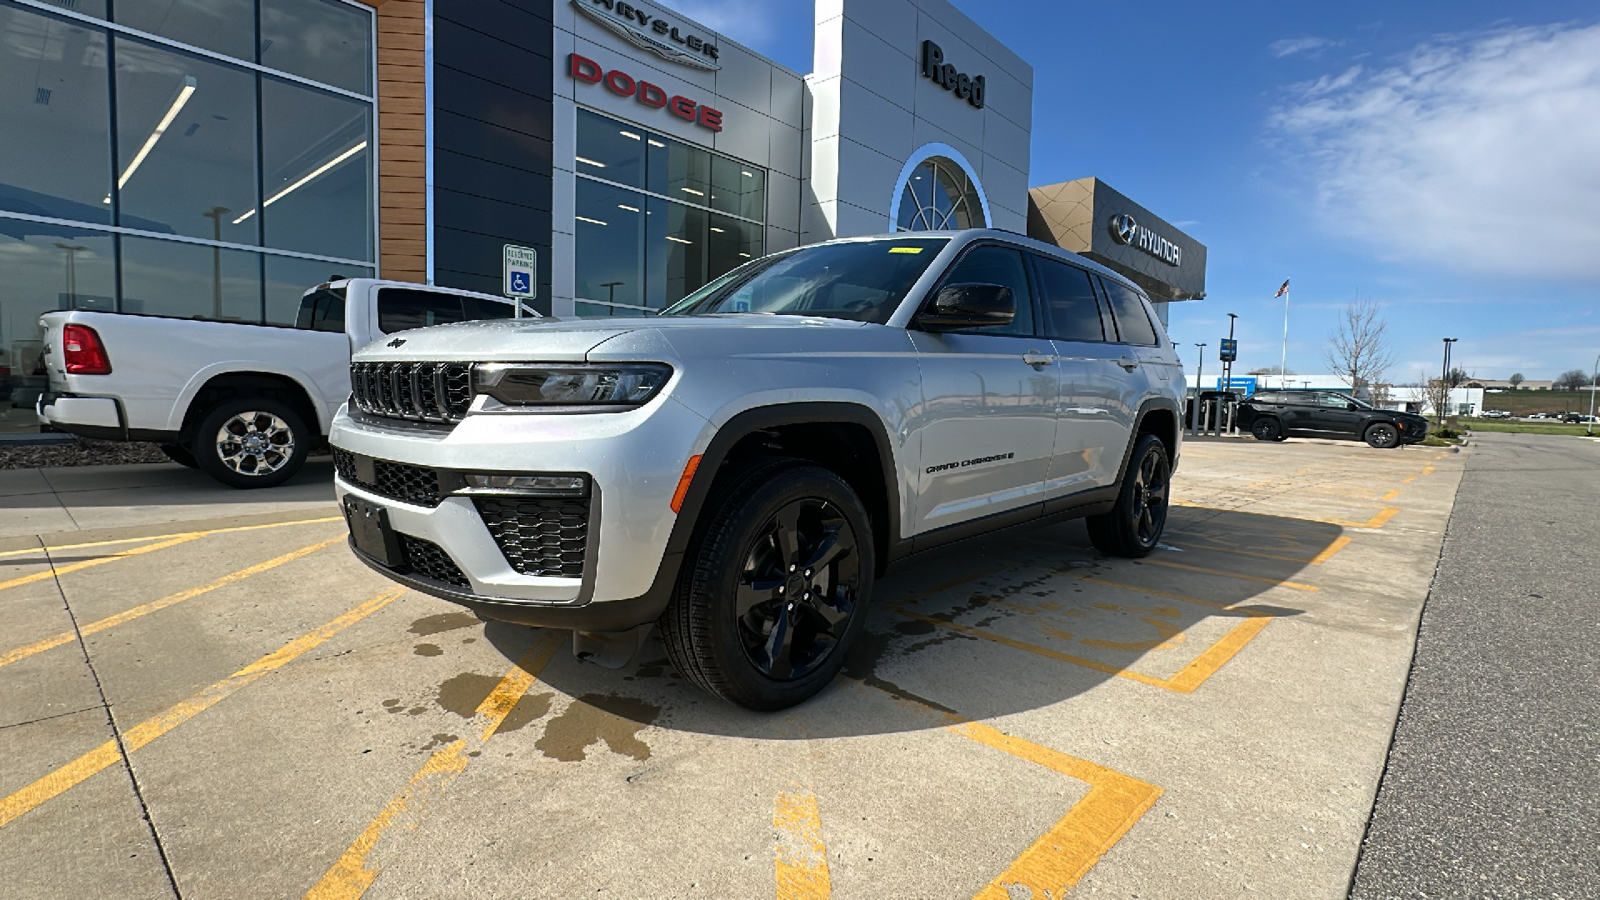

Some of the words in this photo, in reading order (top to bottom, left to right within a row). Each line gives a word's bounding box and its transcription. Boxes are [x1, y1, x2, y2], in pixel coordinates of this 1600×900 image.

[593, 0, 719, 58] HRYSLER
[569, 53, 723, 132] DODGE
[923, 40, 985, 109] Reed
[508, 250, 533, 260] RESERVED
[508, 258, 533, 269] PARKING
[1139, 226, 1182, 266] HYUNDAI
[926, 462, 960, 474] GRAND
[961, 453, 1008, 467] CHEROKEE
